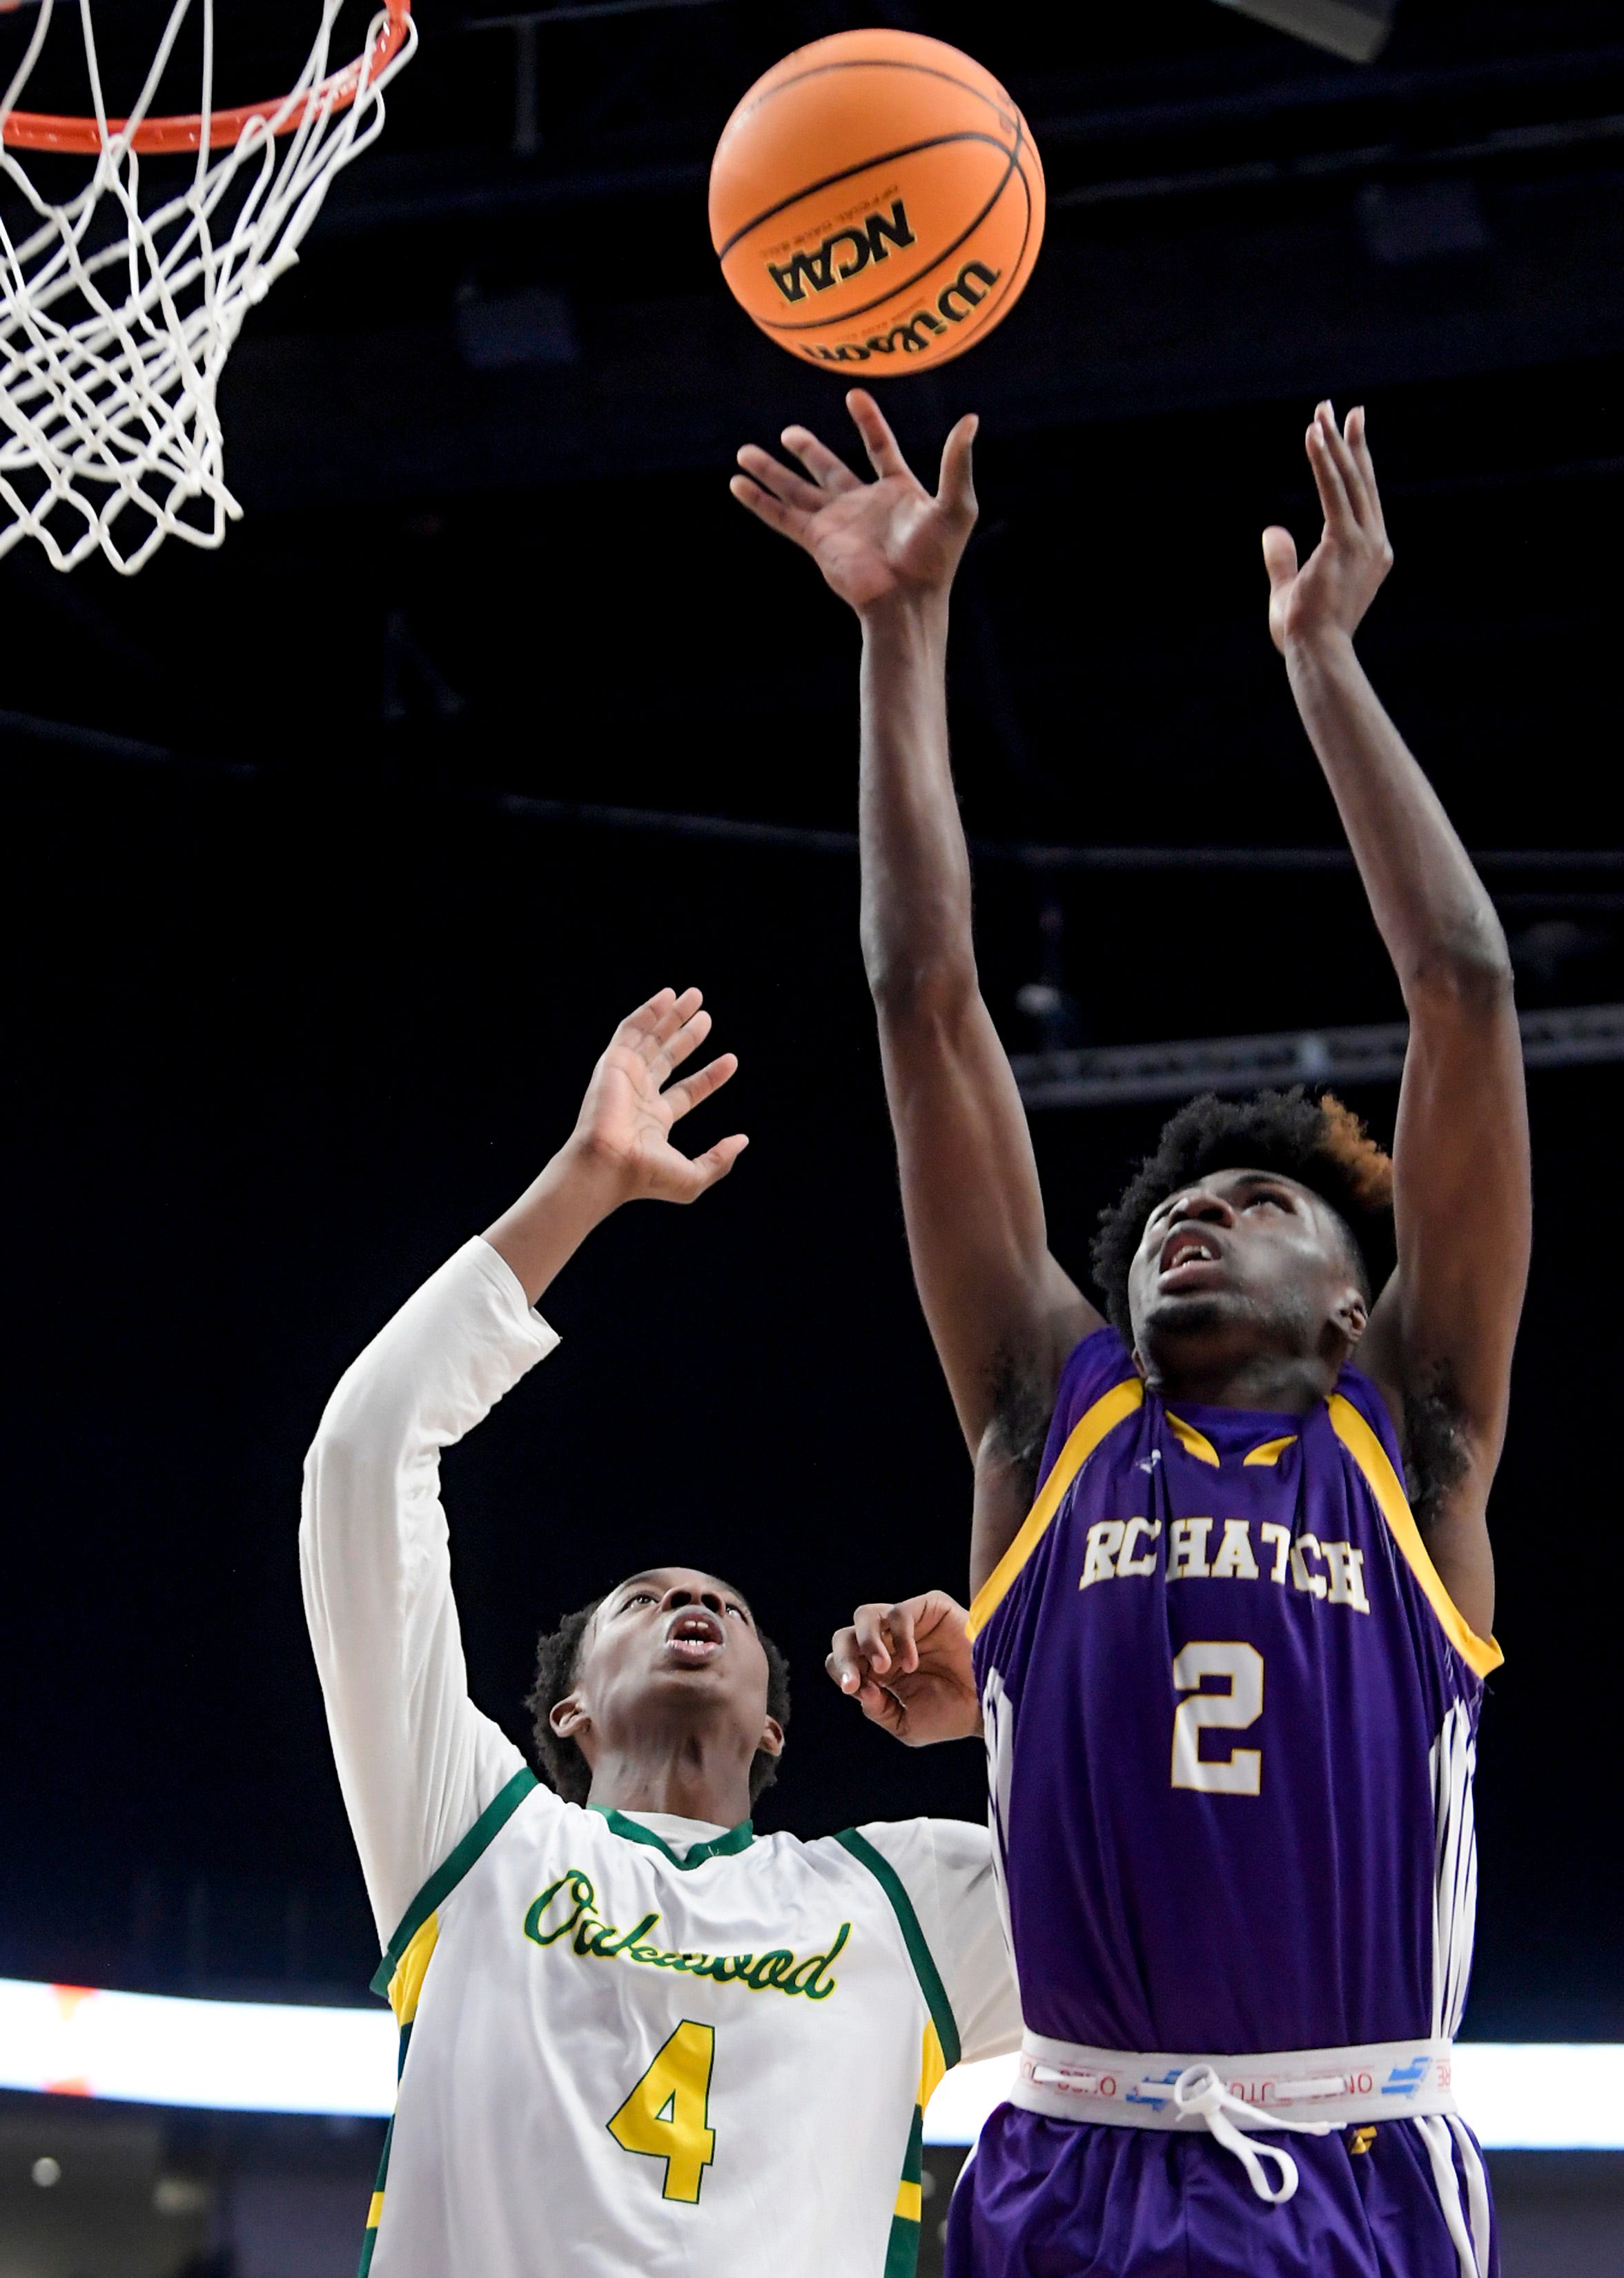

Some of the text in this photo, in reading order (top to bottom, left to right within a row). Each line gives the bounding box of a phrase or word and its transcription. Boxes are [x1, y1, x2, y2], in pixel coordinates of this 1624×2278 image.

[766, 197, 917, 303] NCAA
[798, 260, 1002, 361] Wilson
[1171, 1640, 1264, 1796] 2
[523, 1869, 852, 2000] Oakwood
[605, 2018, 716, 2205] 4
